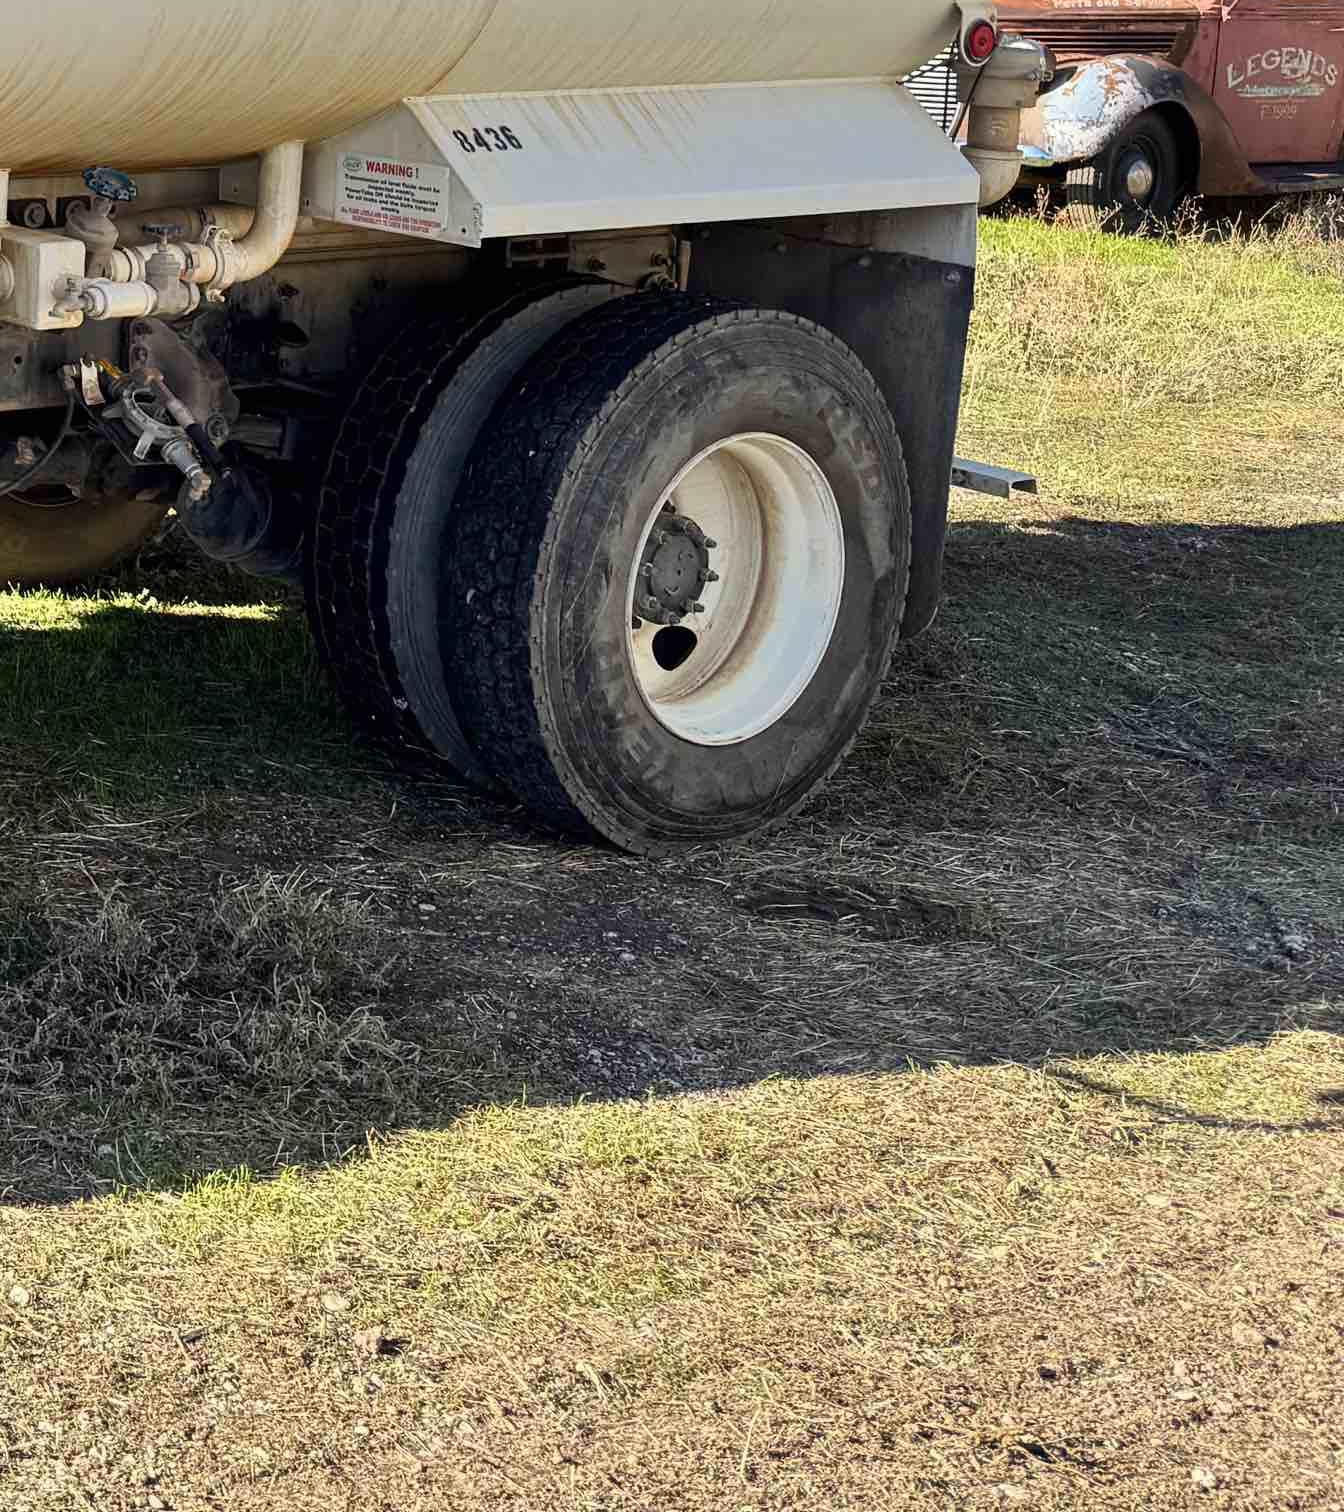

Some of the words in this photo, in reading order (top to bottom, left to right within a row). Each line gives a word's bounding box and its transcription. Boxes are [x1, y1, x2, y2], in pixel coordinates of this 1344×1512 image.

[1226, 47, 1339, 88] LEGENDS
[452, 125, 523, 153] 8436
[366, 160, 413, 178] WARNING
